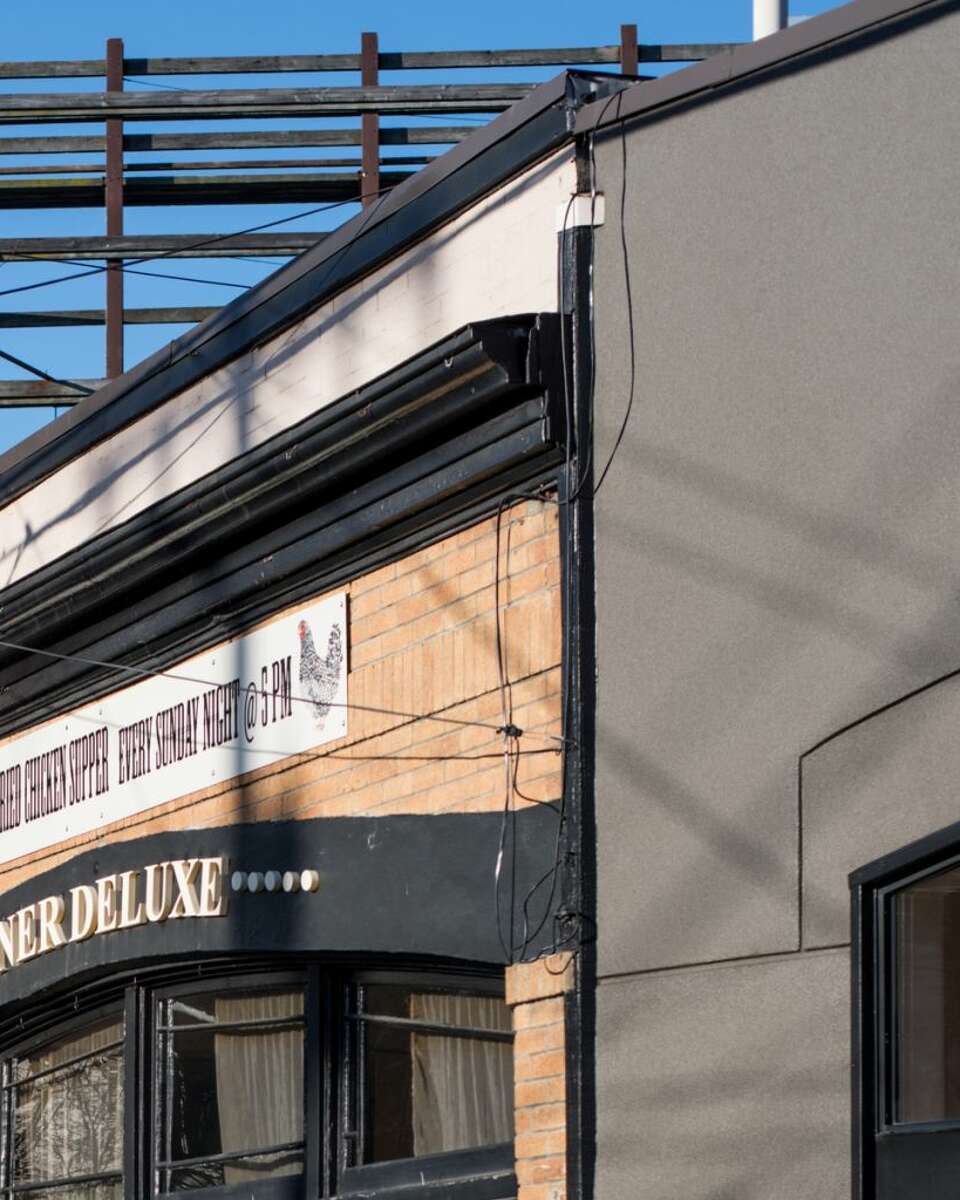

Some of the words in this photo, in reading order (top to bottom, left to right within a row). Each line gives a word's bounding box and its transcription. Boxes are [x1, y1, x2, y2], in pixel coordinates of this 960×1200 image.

[24, 744, 67, 823] CHICKEN
[69, 725, 110, 806] SUPPER
[118, 716, 153, 785] EVERY
[155, 695, 200, 770] SUNDAY
[202, 677, 241, 752] NIGHT
[243, 681, 258, 744] @
[271, 655, 293, 724] PM
[68, 856, 229, 943] DELUXE
